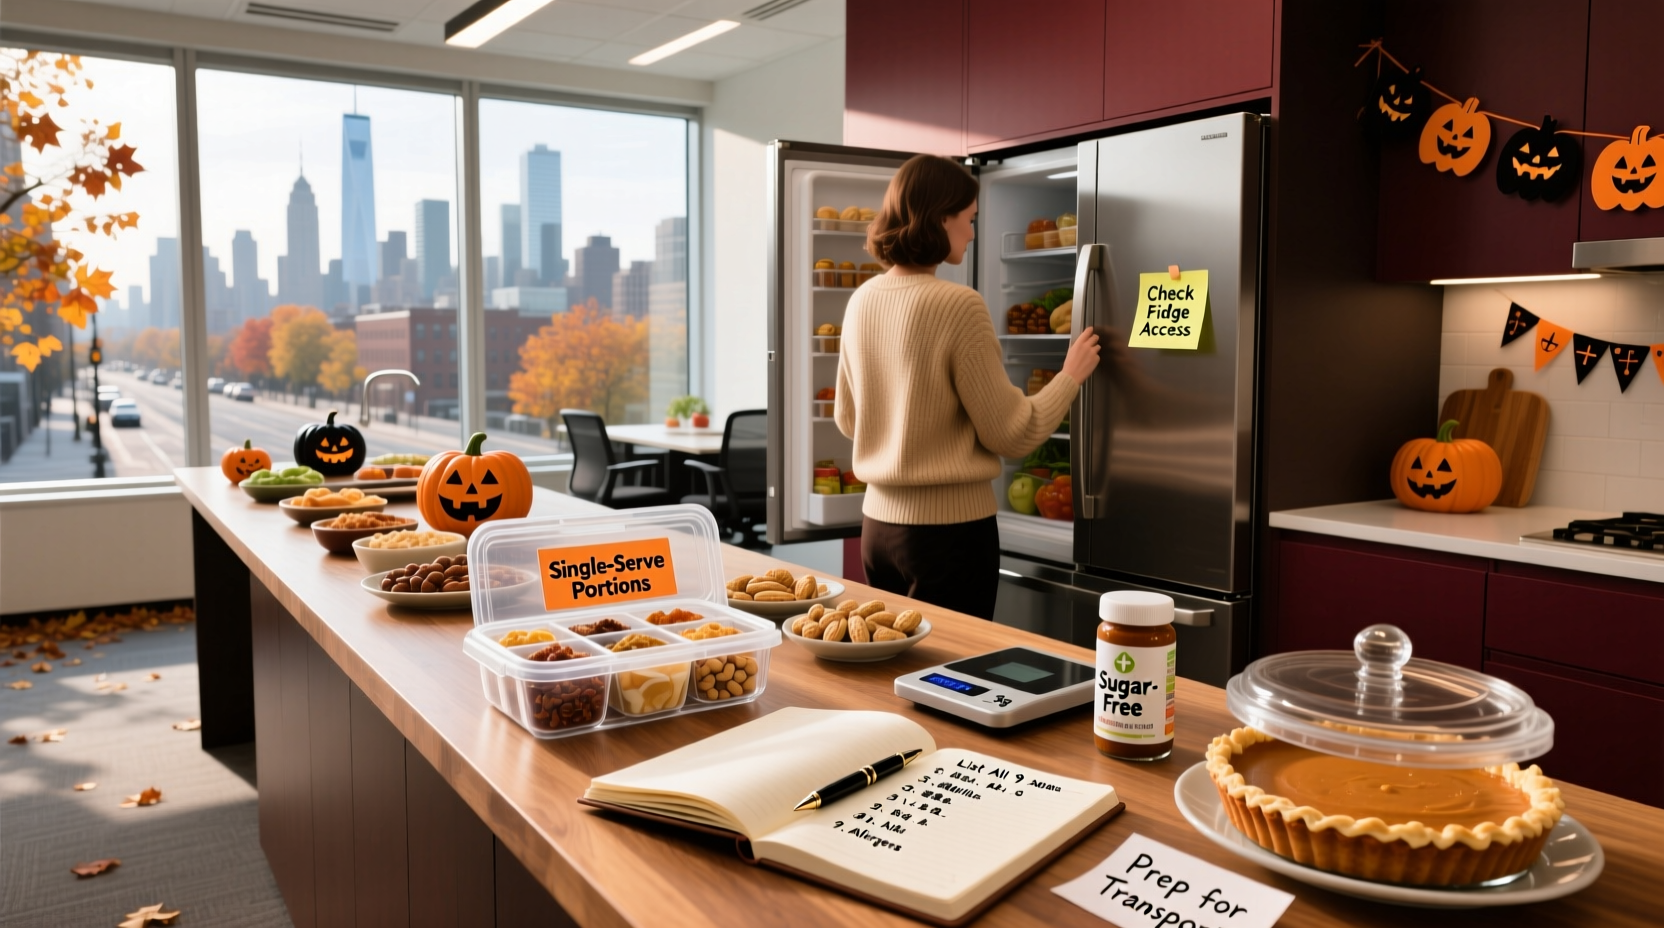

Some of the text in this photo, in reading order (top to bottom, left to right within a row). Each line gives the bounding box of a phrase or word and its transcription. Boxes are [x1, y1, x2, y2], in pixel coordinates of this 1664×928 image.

[1147, 284, 1194, 301] Check
[1146, 303, 1190, 323] Fidge
[1139, 322, 1191, 336] Access
[549, 554, 665, 580] Single-Serve
[572, 576, 652, 600] Portions
[1098, 670, 1158, 700] Sugar-
[1103, 693, 1143, 717] Free
[956, 759, 985, 774] List
[987, 768, 1010, 780] All
[1015, 773, 1025, 784] 9
[1126, 853, 1248, 918] Prep for
[1100, 874, 1222, 928] Transpo
